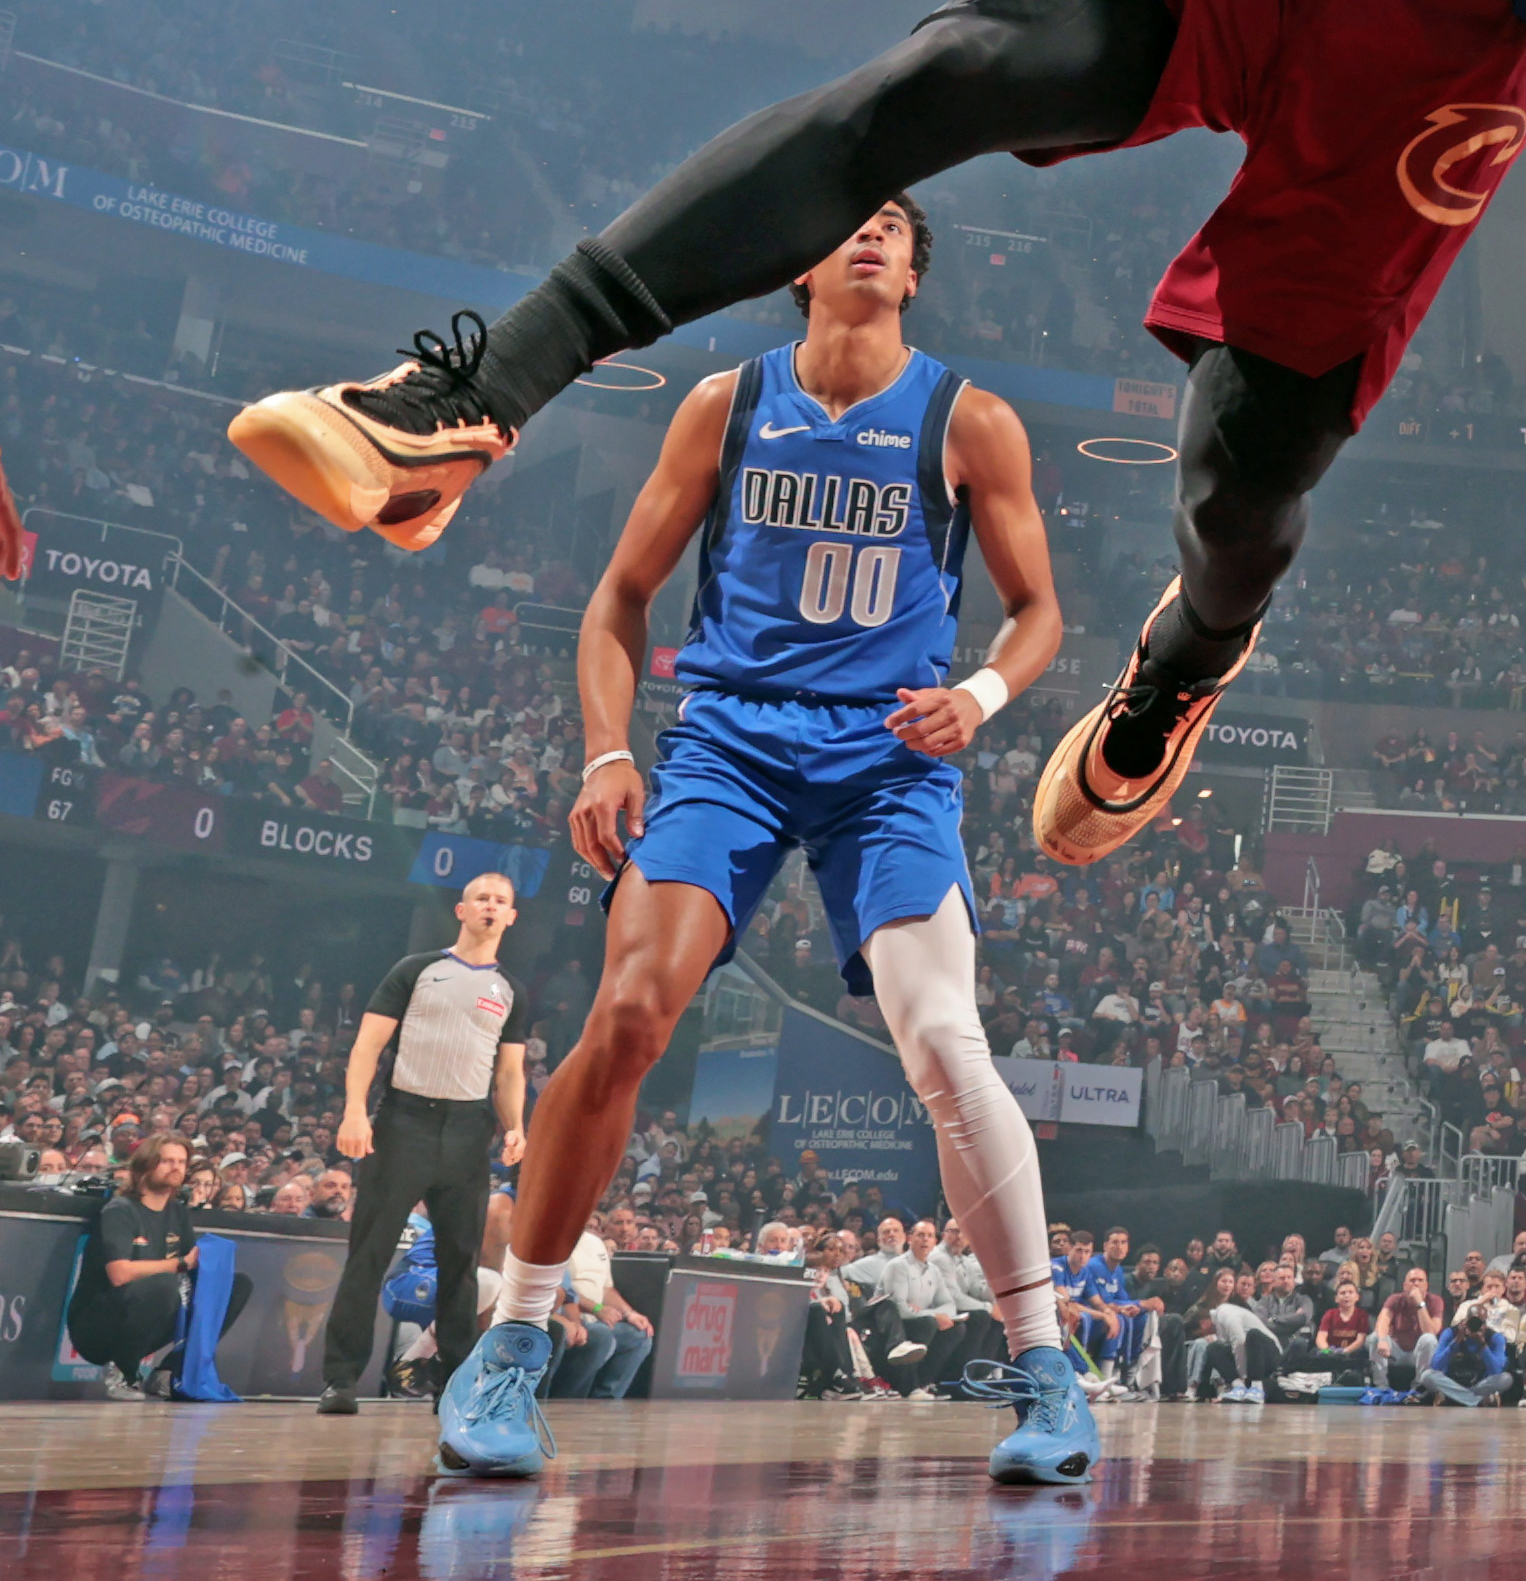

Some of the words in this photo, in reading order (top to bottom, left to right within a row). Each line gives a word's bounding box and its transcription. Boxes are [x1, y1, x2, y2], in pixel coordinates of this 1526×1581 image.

[450, 114, 477, 131] 215
[127, 185, 168, 210] LAKE
[171, 196, 205, 220] ERIE
[207, 208, 278, 239] COLLEGE
[93, 194, 117, 211] OF
[119, 202, 226, 245] OSTEOPATHIC
[229, 232, 310, 265] MEDICINE
[966, 234, 990, 247] 215
[1008, 240, 1032, 253] 216
[1117, 380, 1174, 399] TONIGHT'S
[857, 428, 911, 449] chime
[742, 467, 911, 537] DALLAS
[45, 549, 153, 591] TOYOTA
[800, 542, 901, 627] 00
[642, 681, 684, 695] TOYOTA
[1206, 724, 1298, 750] TOYOTA
[47, 800, 74, 822] 67
[194, 807, 214, 839] 0
[260, 820, 374, 863] BLOCKS
[434, 846, 453, 877] 0
[569, 886, 591, 906] 60
[1070, 1085, 1130, 1104] ULTRA
[686, 1303, 727, 1342] drug
[682, 1345, 731, 1373] mart
